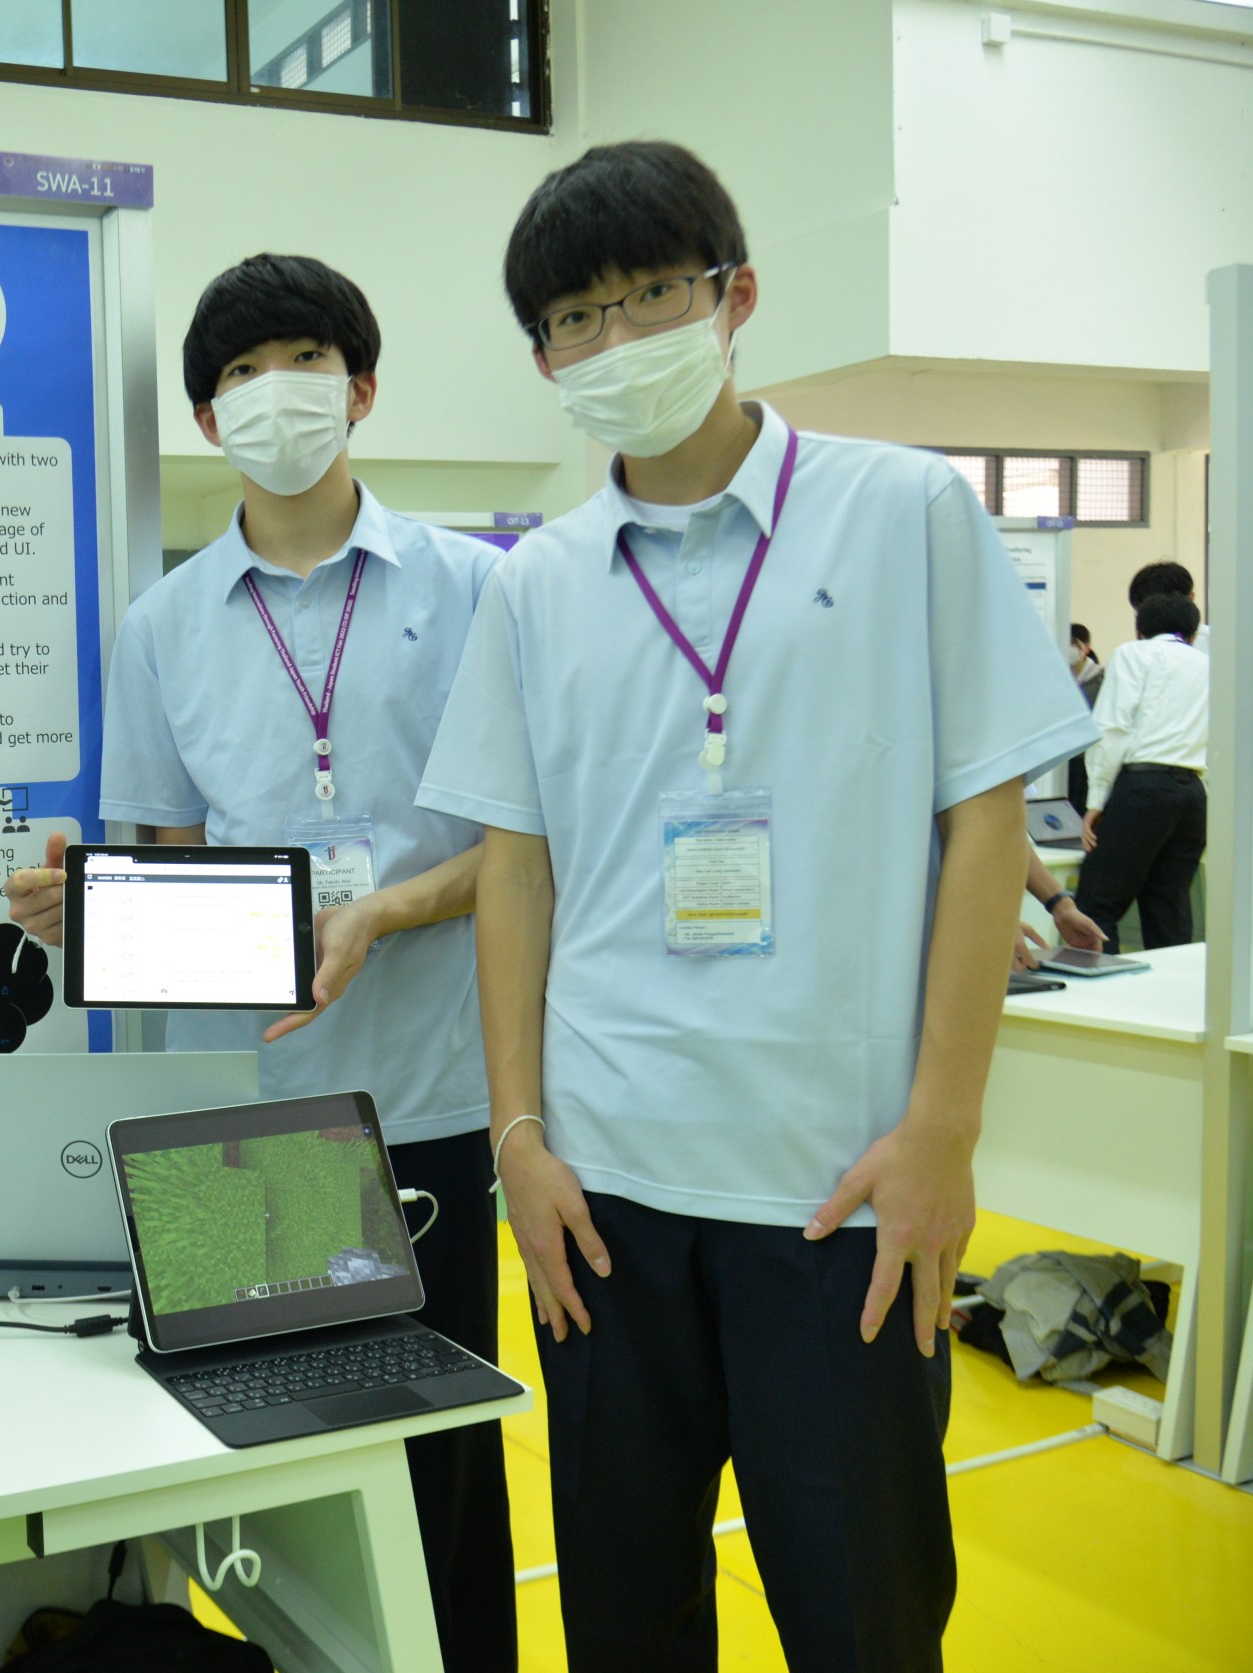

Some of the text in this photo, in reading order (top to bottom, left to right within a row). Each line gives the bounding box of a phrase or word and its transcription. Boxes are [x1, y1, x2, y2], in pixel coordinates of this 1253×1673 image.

[37, 171, 114, 197] SWA-11
[31, 454, 58, 467] two
[30, 522, 45, 536] of
[42, 592, 68, 605] and
[8, 732, 31, 748] get
[36, 732, 73, 743] more
[66, 1154, 99, 1165] DELL
